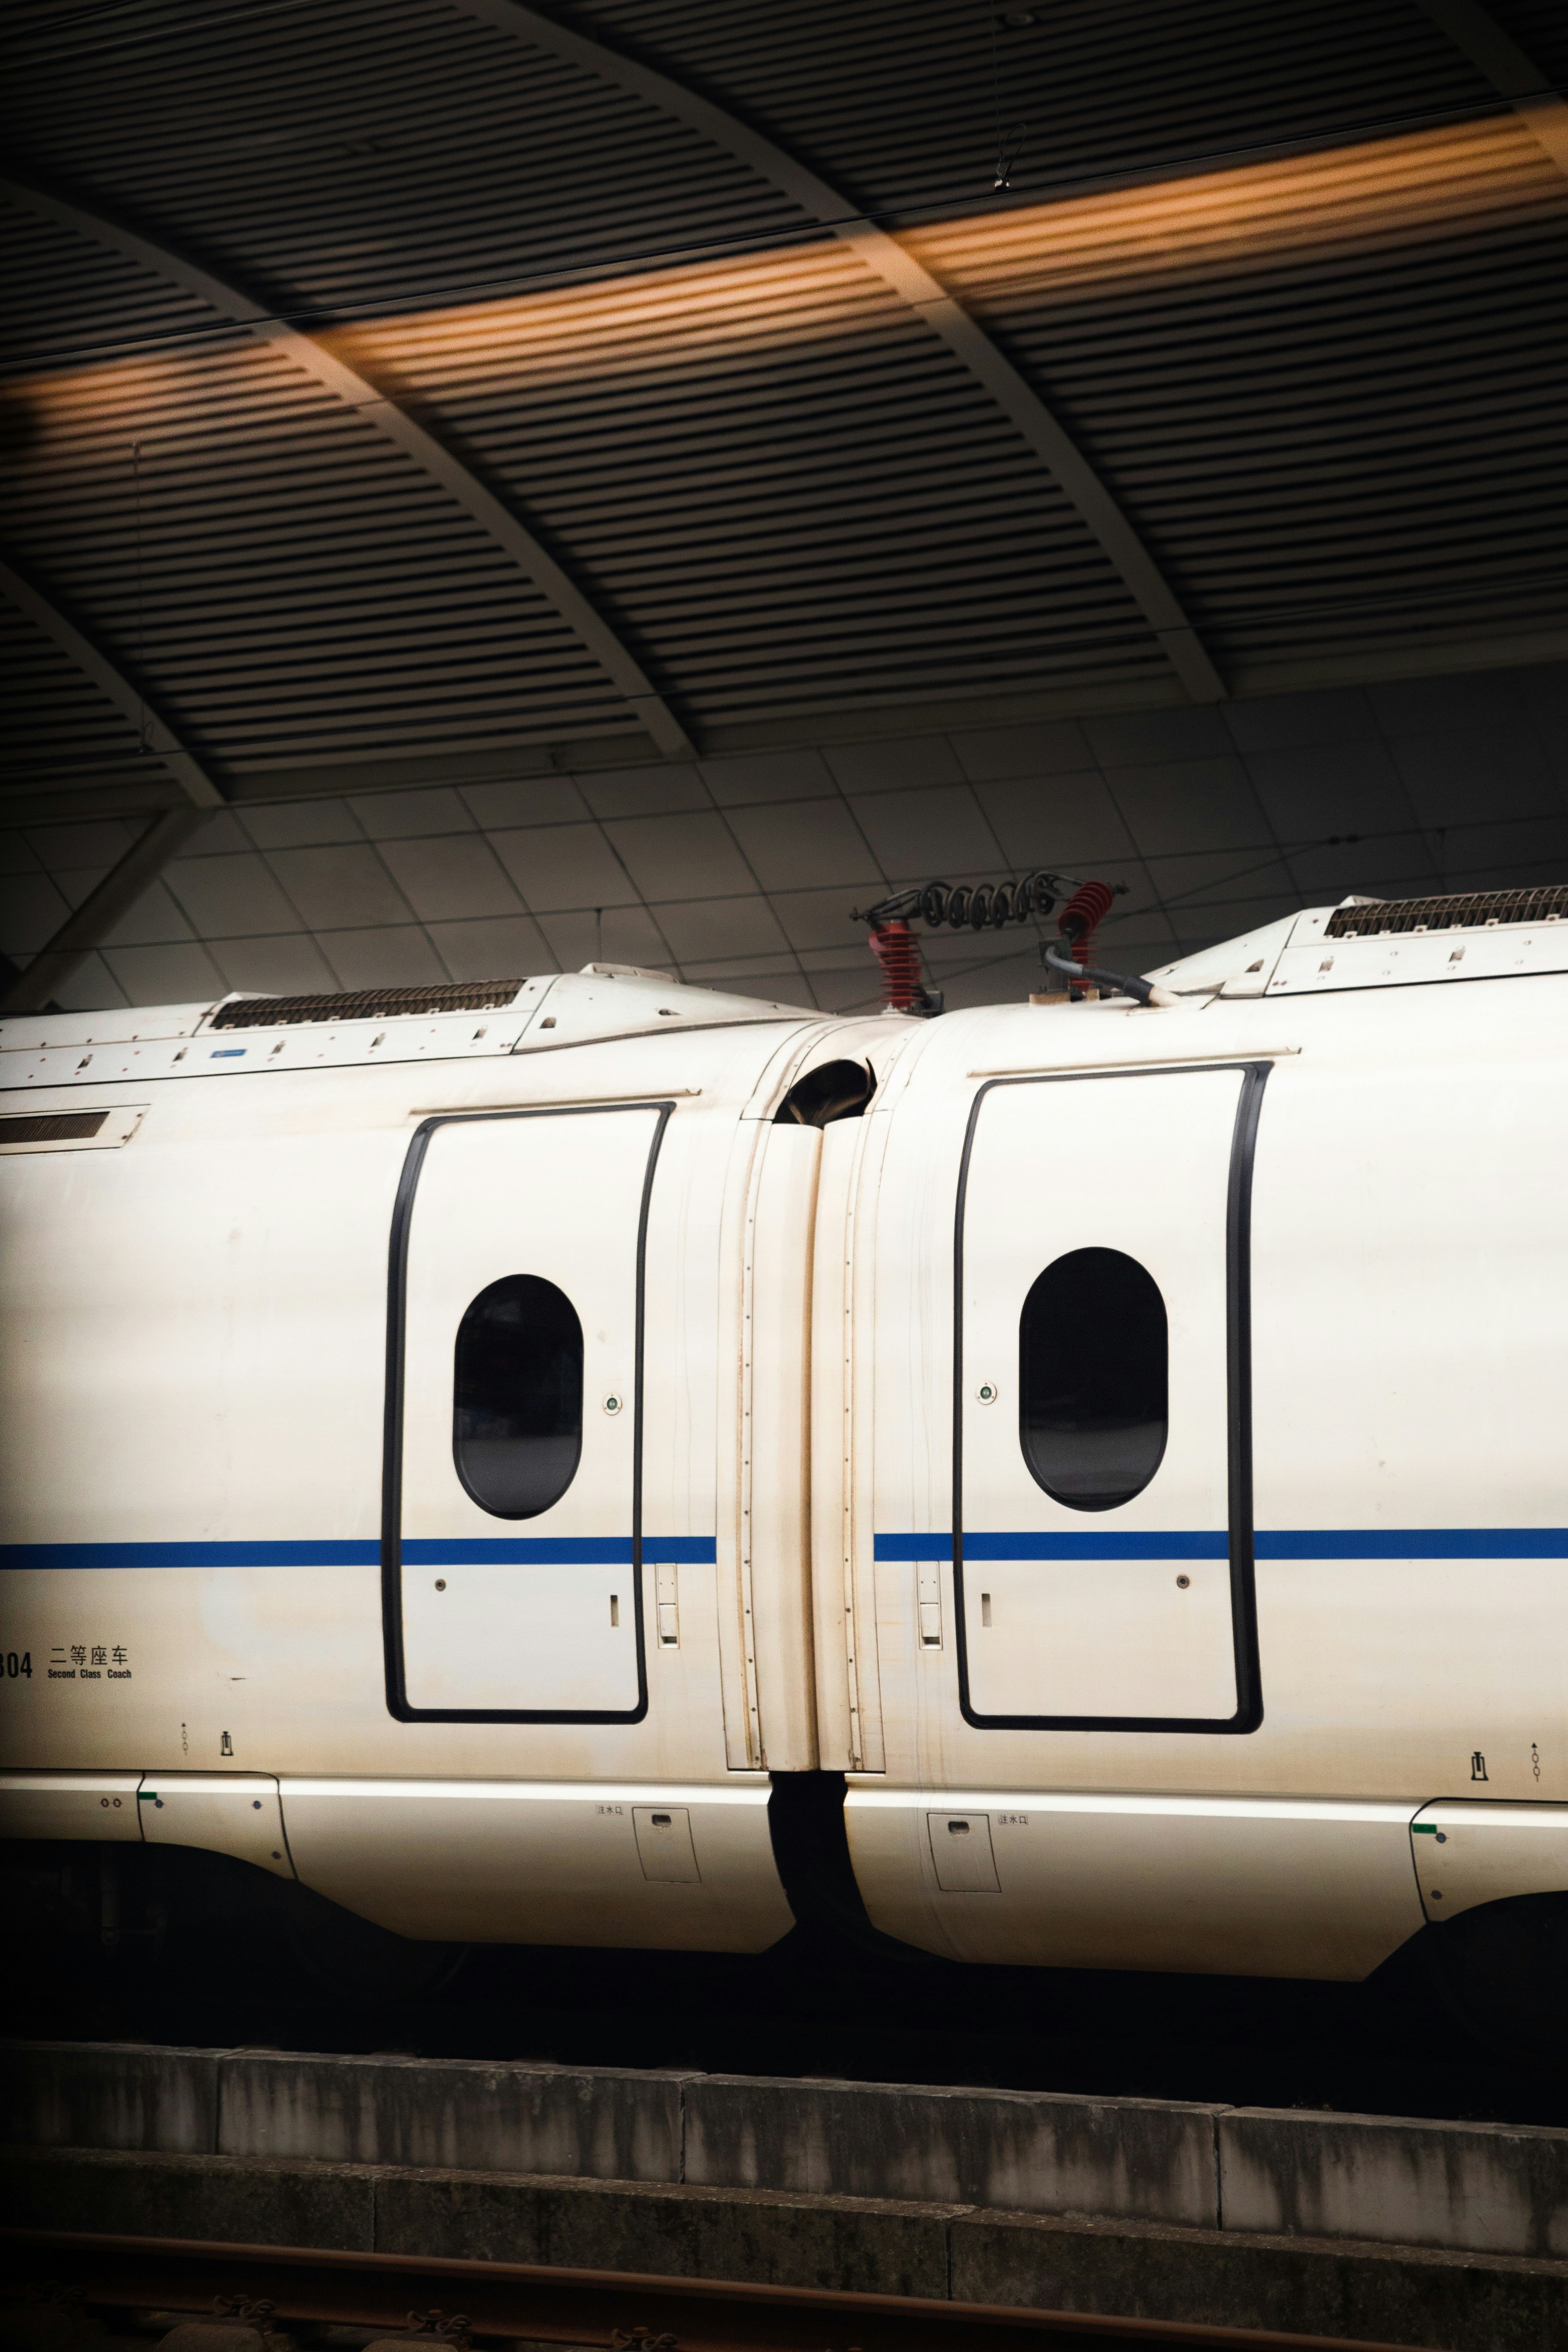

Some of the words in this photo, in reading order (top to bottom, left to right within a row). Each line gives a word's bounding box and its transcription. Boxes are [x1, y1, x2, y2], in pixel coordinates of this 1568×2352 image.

[50, 1645, 128, 1666] 二等座车
[48, 1669, 76, 1679] Second
[80, 1669, 101, 1679] Class
[107, 1669, 132, 1679] Coach
[598, 1805, 623, 1815] 注水口
[1000, 1815, 1027, 1824] 注水口
